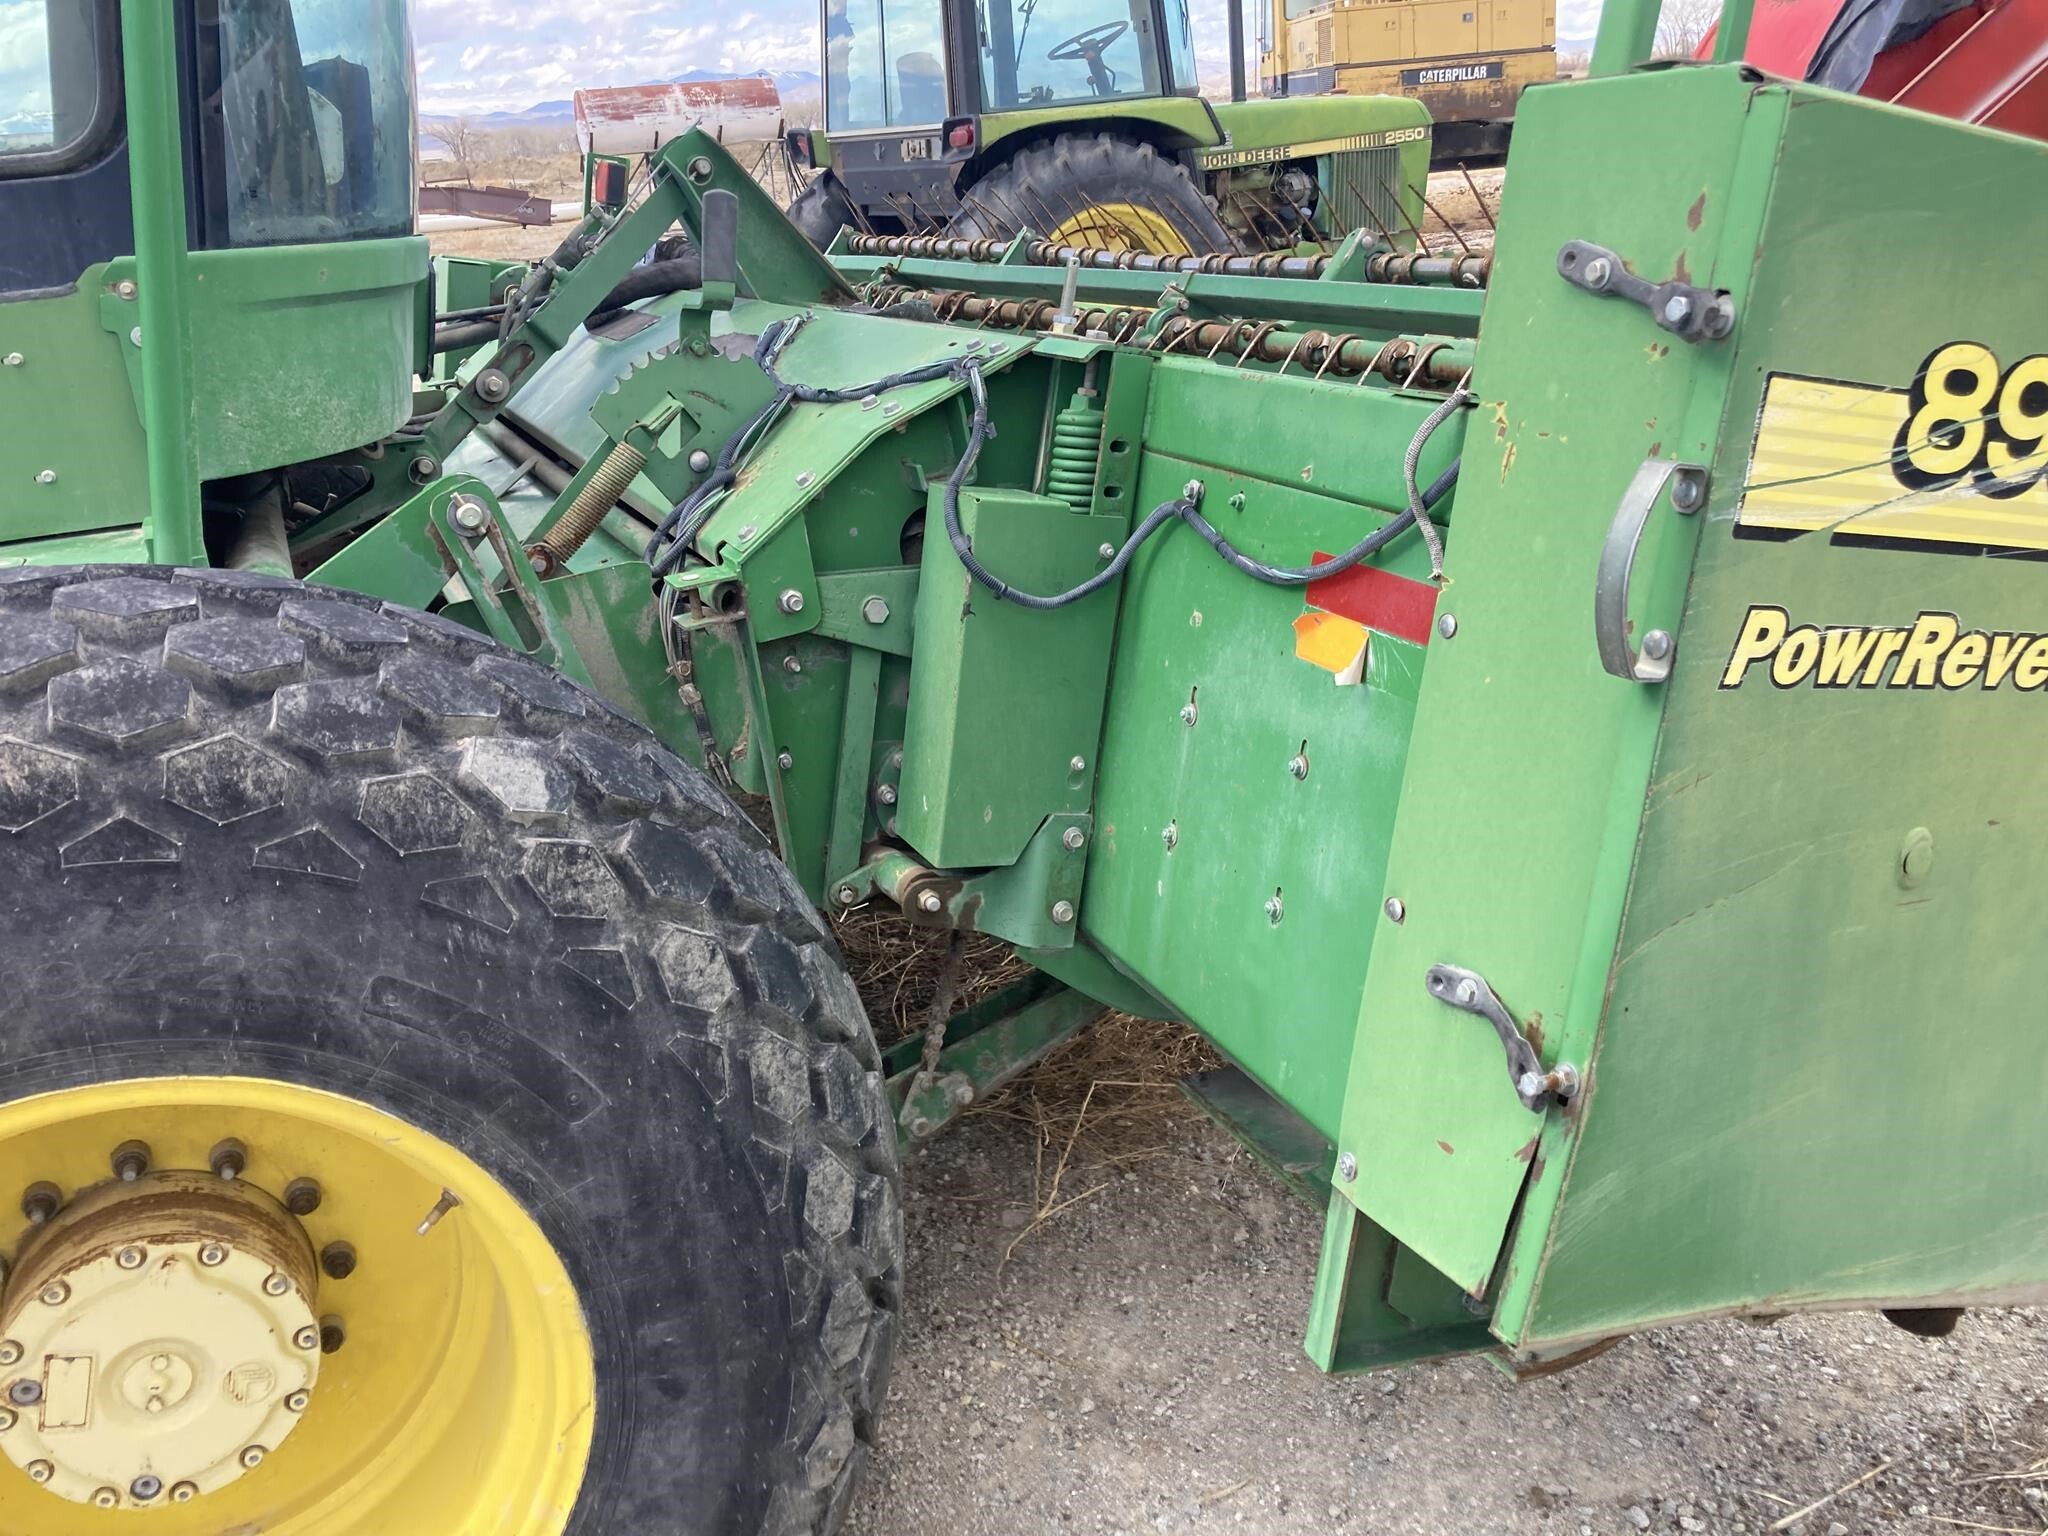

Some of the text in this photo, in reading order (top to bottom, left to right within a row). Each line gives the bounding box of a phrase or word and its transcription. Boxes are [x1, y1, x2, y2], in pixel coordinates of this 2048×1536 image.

[1419, 65, 1487, 84] CATERPILLAR
[1202, 127, 1425, 168] JOHN DEERE 2550
